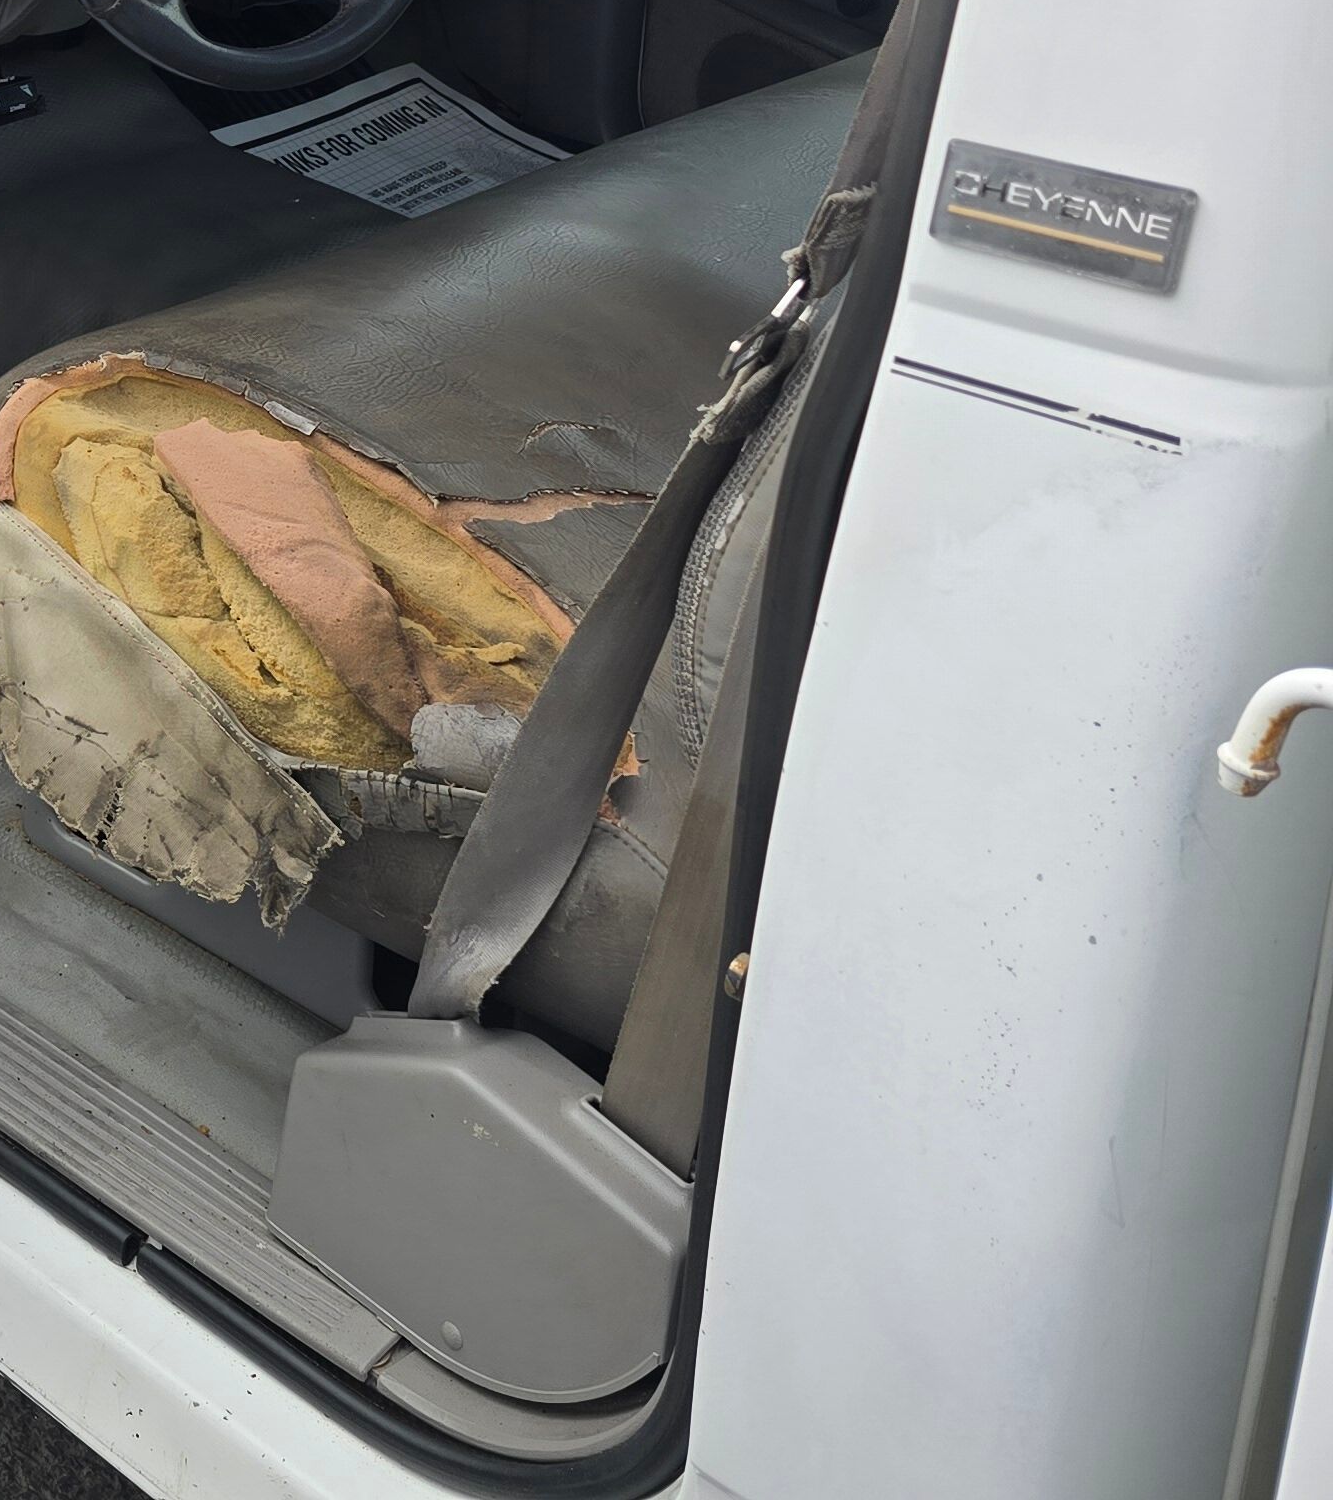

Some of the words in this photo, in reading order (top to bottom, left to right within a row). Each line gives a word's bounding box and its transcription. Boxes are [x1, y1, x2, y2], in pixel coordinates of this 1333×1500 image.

[316, 134, 365, 161] FOR
[352, 105, 428, 146] COMING
[414, 95, 448, 118] IN
[953, 169, 1174, 240] CHEYENNE
